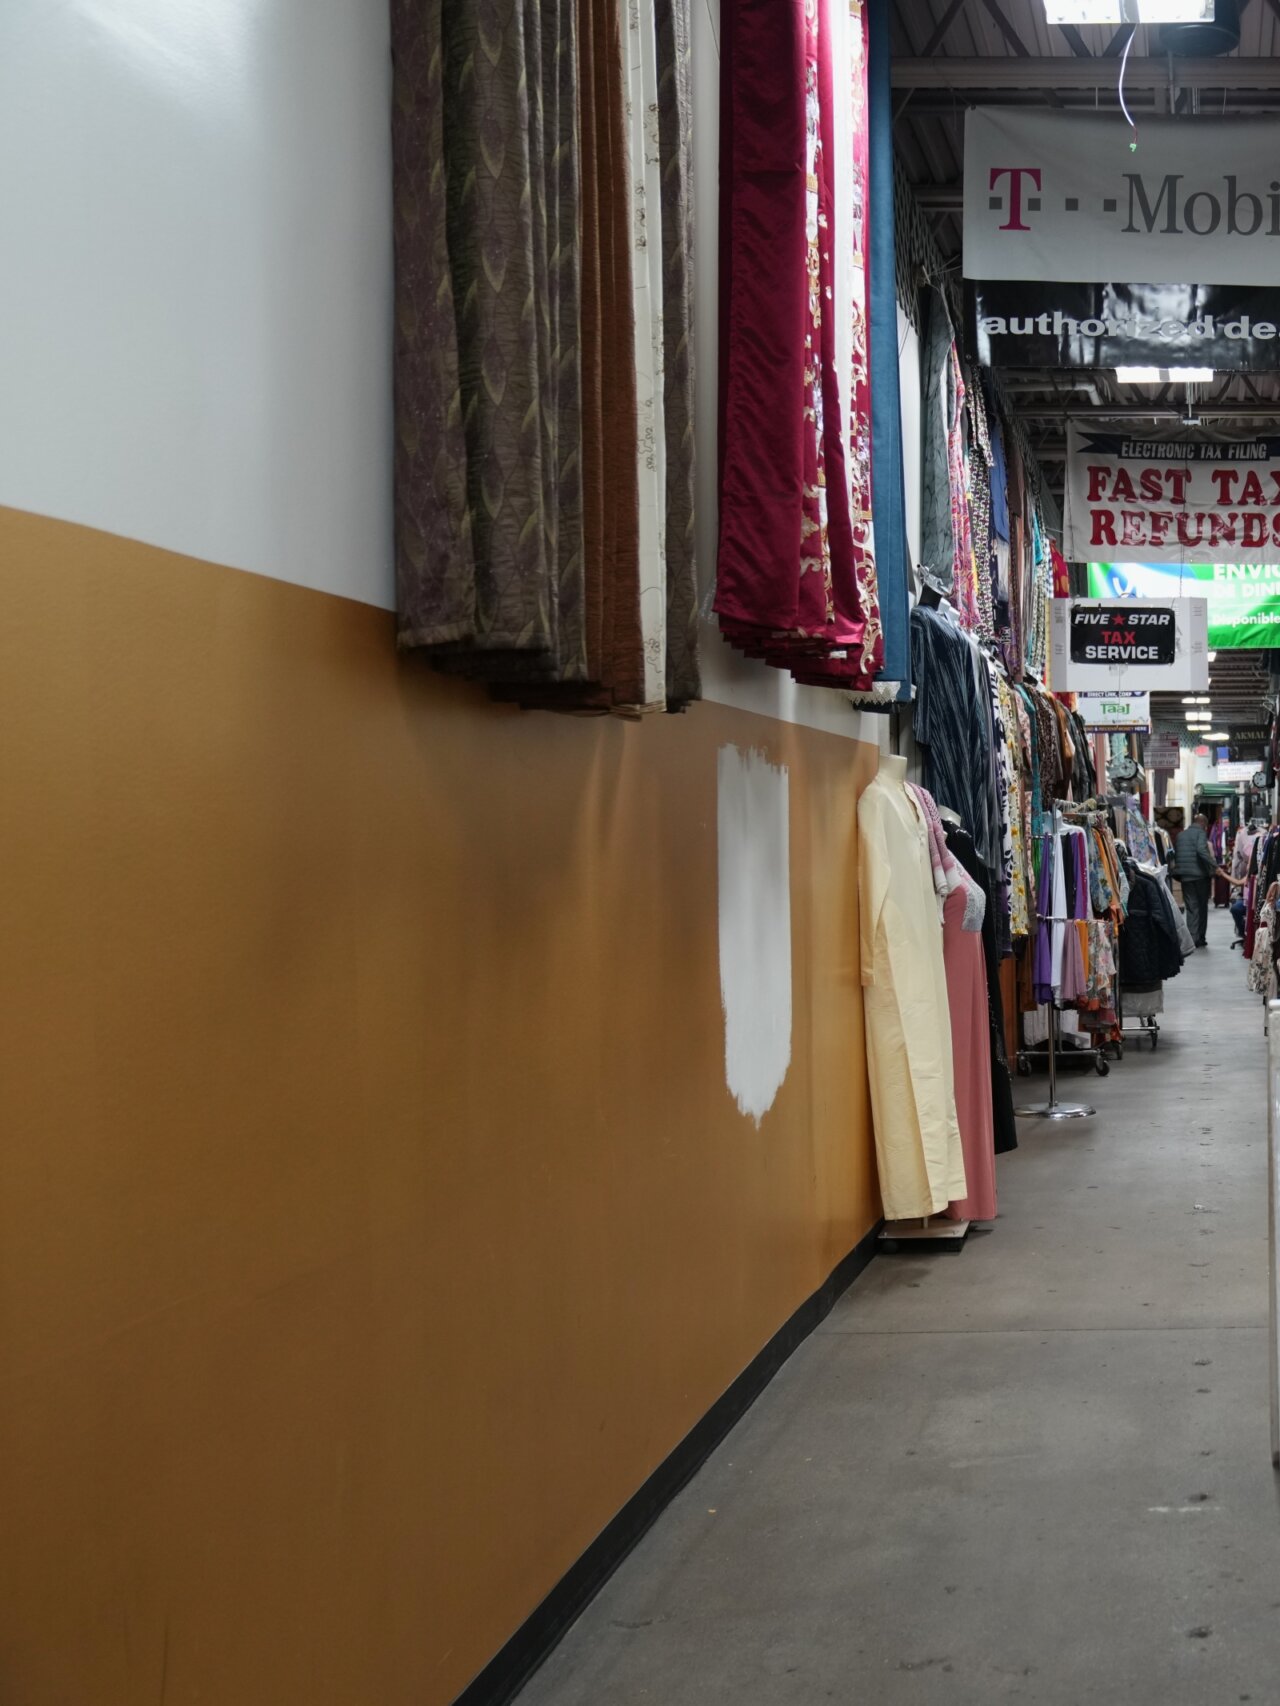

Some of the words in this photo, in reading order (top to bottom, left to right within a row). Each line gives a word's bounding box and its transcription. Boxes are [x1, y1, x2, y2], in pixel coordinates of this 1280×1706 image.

[982, 312, 1214, 340] authorized
[1121, 442, 1195, 460] ELECTRONIC
[1200, 443, 1223, 459] TAX
[1228, 443, 1268, 460] FILING
[1087, 466, 1192, 505] FAST
[1074, 614, 1109, 626] FIVE
[1128, 614, 1171, 626] STAR
[1101, 631, 1136, 645] TAX
[1085, 646, 1159, 660] SERVICE
